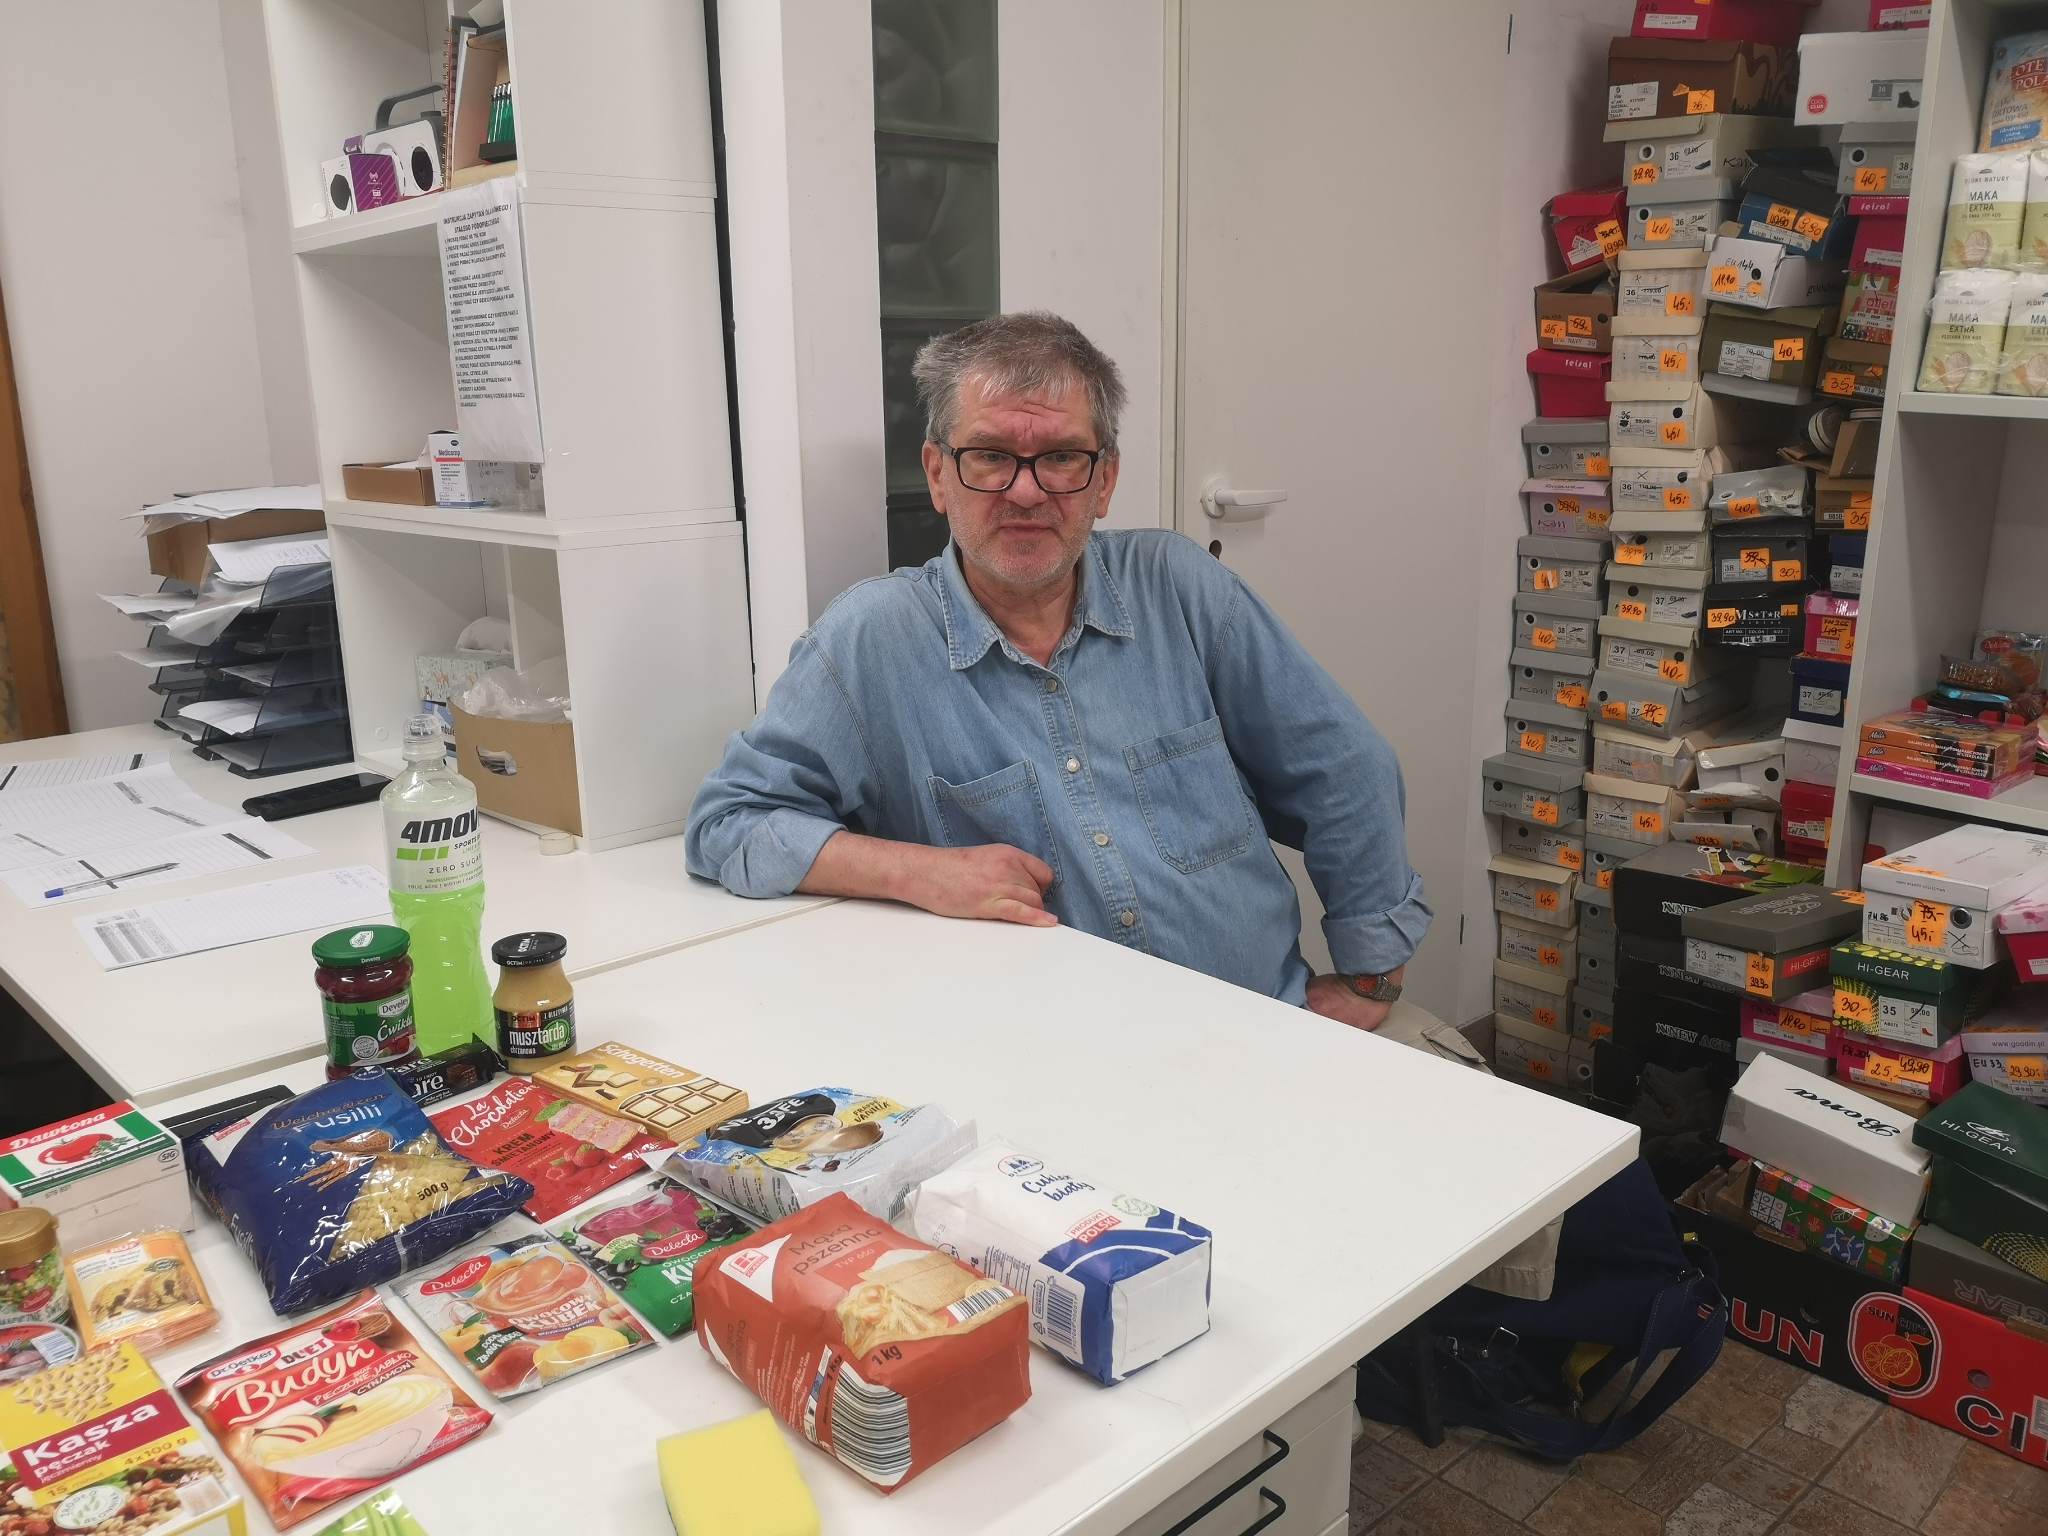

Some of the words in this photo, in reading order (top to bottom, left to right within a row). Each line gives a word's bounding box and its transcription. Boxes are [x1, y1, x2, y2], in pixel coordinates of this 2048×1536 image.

[1669, 151, 1680, 161] 36
[1898, 162, 1909, 171] 38
[1969, 203, 1994, 213] EXTRA
[1622, 483, 1632, 491] 36
[1654, 596, 1665, 606] 37
[1614, 645, 1626, 655] 37
[1802, 691, 1812, 699] 37
[400, 806, 479, 844] 4MOV
[428, 864, 456, 874] ZERO
[1695, 949, 1707, 960] 33
[1857, 961, 1911, 981] HI-GEAR
[382, 996, 409, 1014] Devele
[1883, 1005, 1898, 1016] 35
[509, 1022, 565, 1046] musztarda
[464, 1101, 490, 1121] La
[9, 1112, 107, 1149] Dawtona
[1941, 1118, 2017, 1156] HI-GEAR
[494, 1131, 535, 1155] KREM
[416, 1184, 440, 1201] 500
[789, 1223, 853, 1255] Mąka
[1079, 1215, 1122, 1244] POLSKI
[651, 1232, 704, 1257] Delecta
[793, 1227, 882, 1276] pszenna
[431, 1260, 487, 1292] Delecta
[1697, 1296, 1825, 1368] UN
[281, 1338, 330, 1365] DUET
[881, 1344, 902, 1361] kg
[221, 1344, 375, 1425] Budyń
[313, 1371, 369, 1404] PIECZONE
[357, 1362, 412, 1395] CYNAMON
[22, 1403, 160, 1466] Kasza
[34, 1441, 112, 1479] pęczak
[48, 1484, 68, 1498] 15
